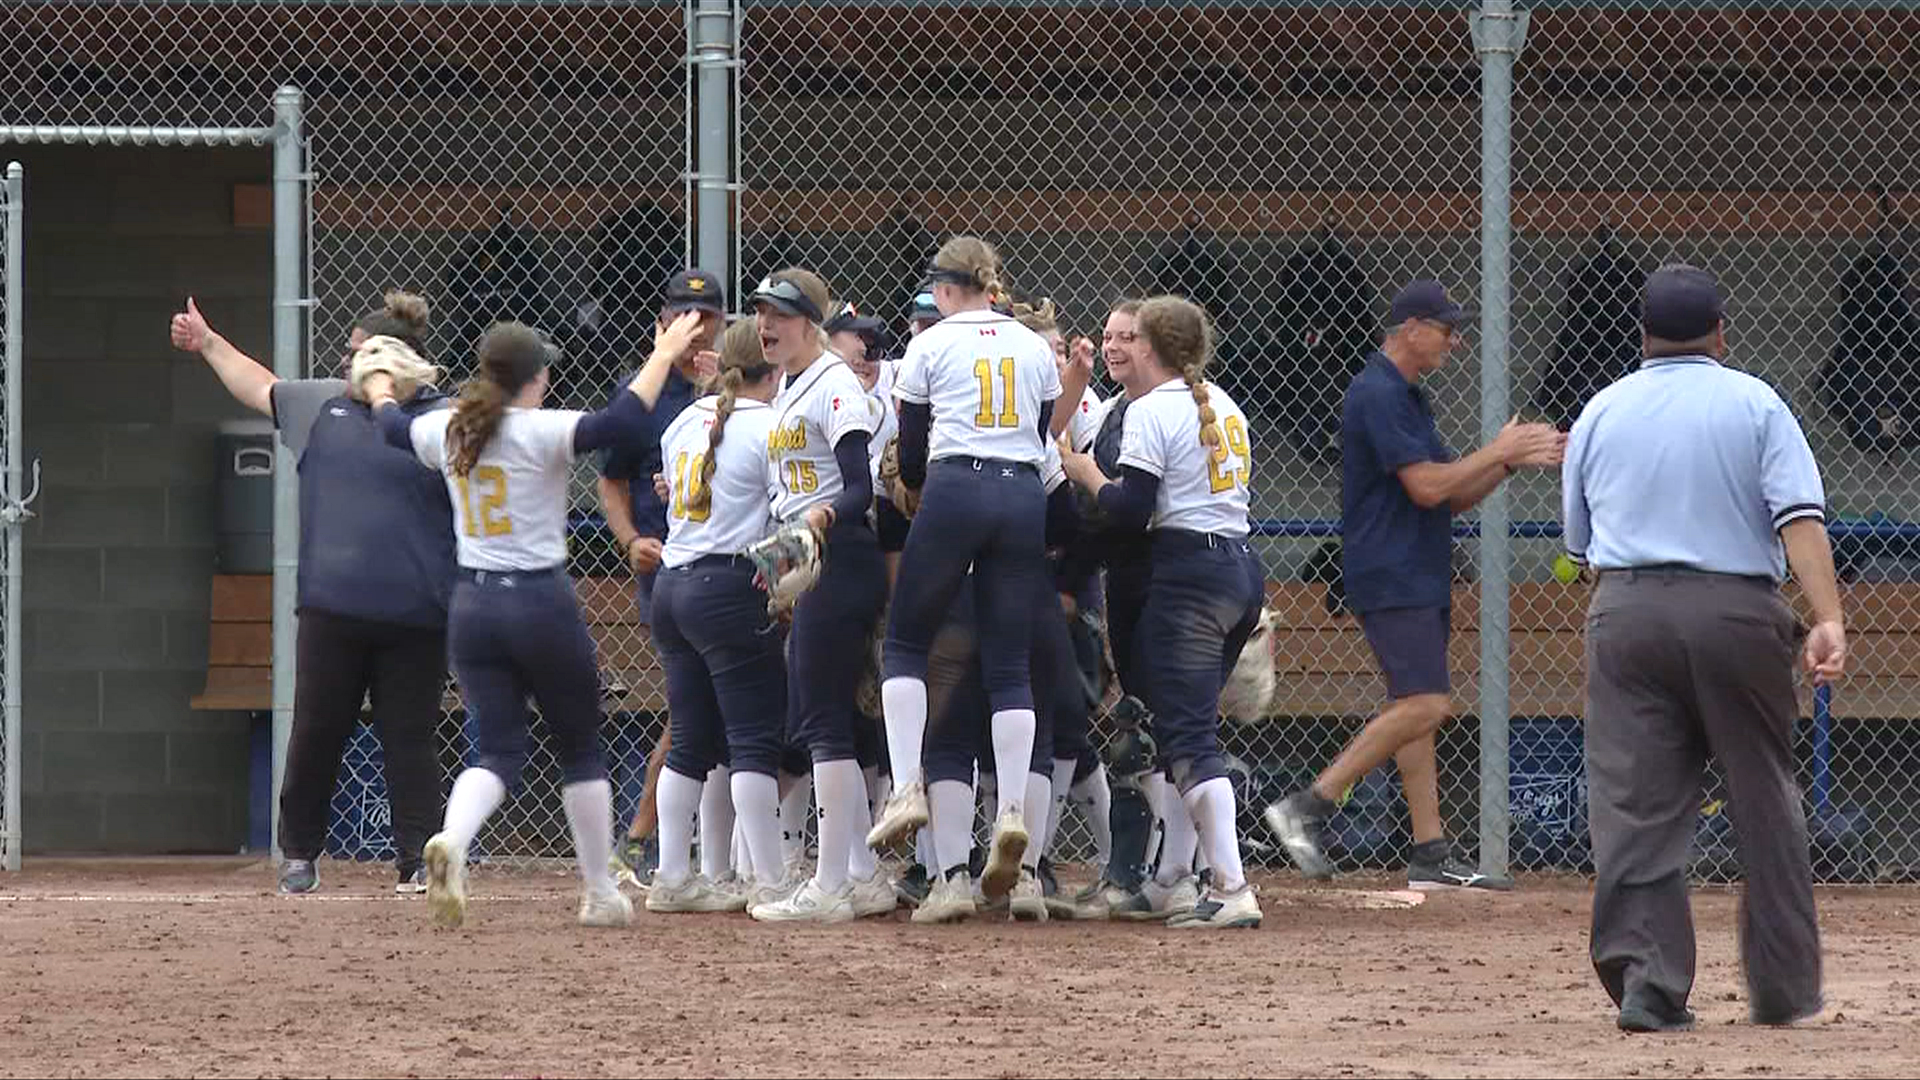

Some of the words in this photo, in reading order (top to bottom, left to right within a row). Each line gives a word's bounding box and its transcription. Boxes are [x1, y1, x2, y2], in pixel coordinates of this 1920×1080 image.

[974, 357, 1018, 428] 11
[787, 459, 818, 494] 15
[1206, 415, 1250, 494] 29
[457, 464, 512, 538] 12
